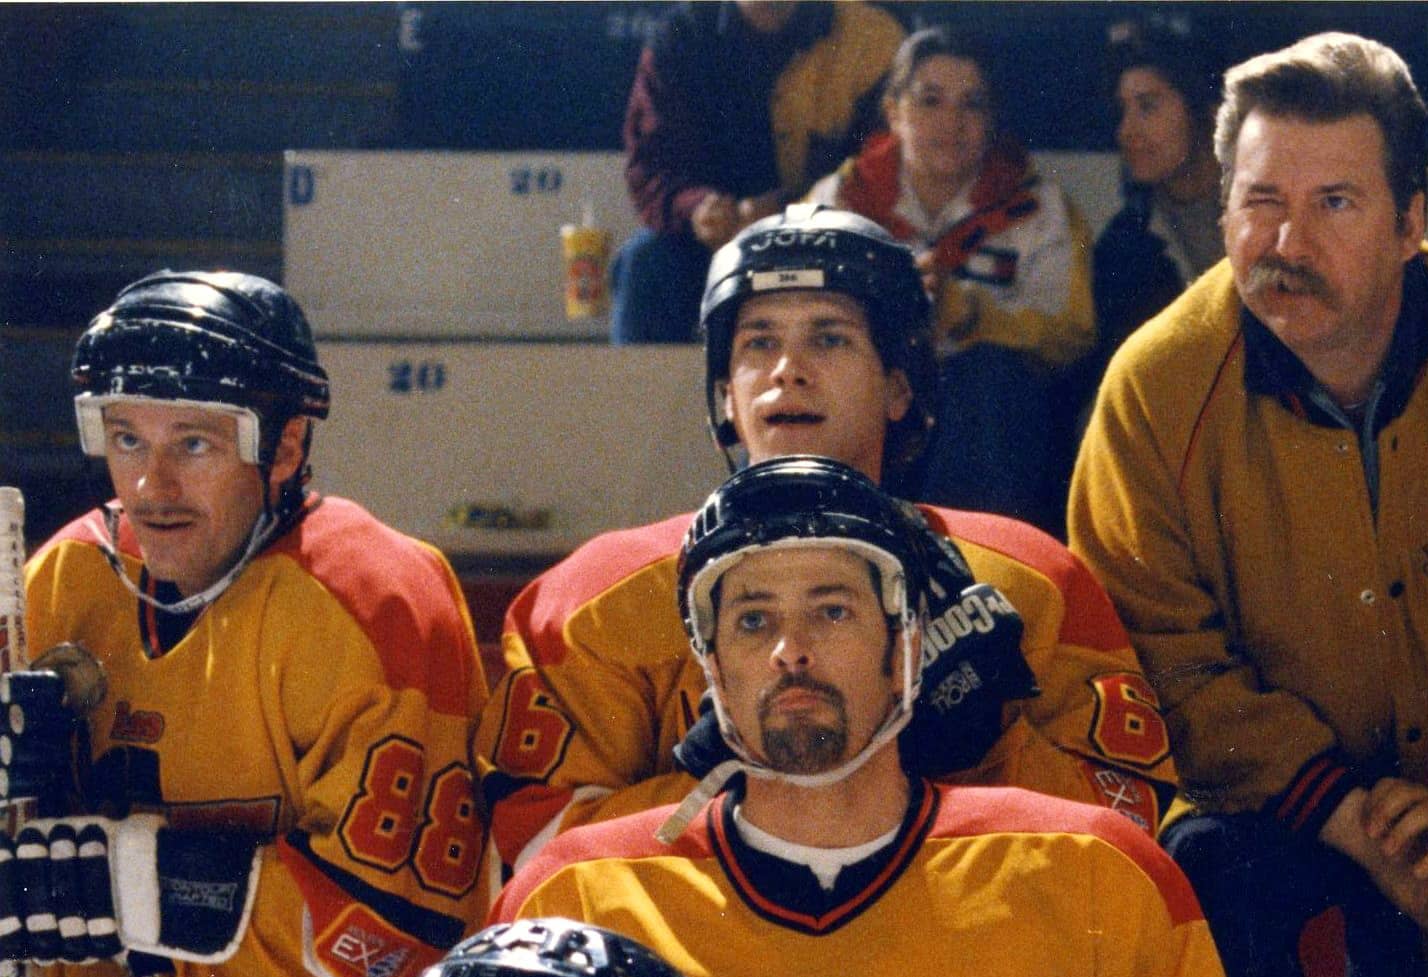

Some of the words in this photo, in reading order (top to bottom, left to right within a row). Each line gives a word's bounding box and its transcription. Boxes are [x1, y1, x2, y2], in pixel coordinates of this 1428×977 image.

[289, 166, 314, 204] D
[510, 168, 562, 195] 20
[387, 360, 446, 392] 20
[492, 666, 576, 783] 6
[1086, 670, 1172, 770] 6
[337, 734, 490, 900] 88
[331, 934, 384, 975] EX
